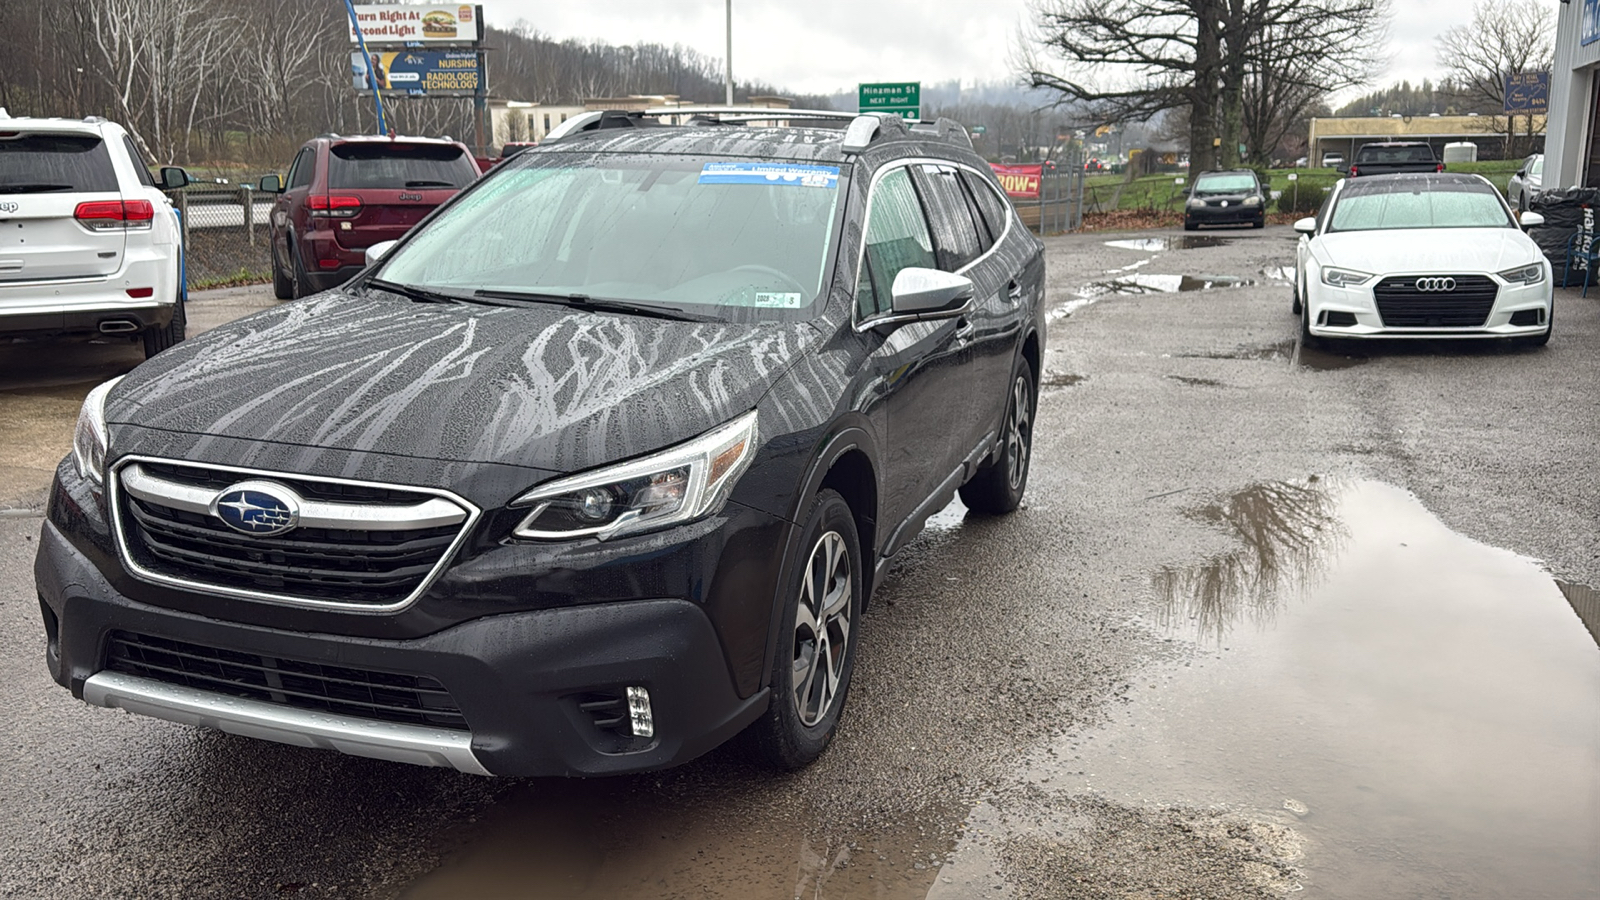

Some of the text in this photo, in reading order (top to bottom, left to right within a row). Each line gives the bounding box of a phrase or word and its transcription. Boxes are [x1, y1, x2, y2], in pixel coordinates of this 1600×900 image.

[379, 10, 406, 23] Right
[409, 11, 420, 20] At
[389, 25, 415, 37] Light
[438, 59, 477, 68] NURSING
[426, 72, 478, 81] RADIOLOGIC
[421, 80, 479, 89] TECHNOLOGY
[863, 85, 916, 94] Hinzman St
[788, 167, 833, 176] Warranty
[399, 193, 422, 201] Jeep
[0, 202, 19, 213] ep
